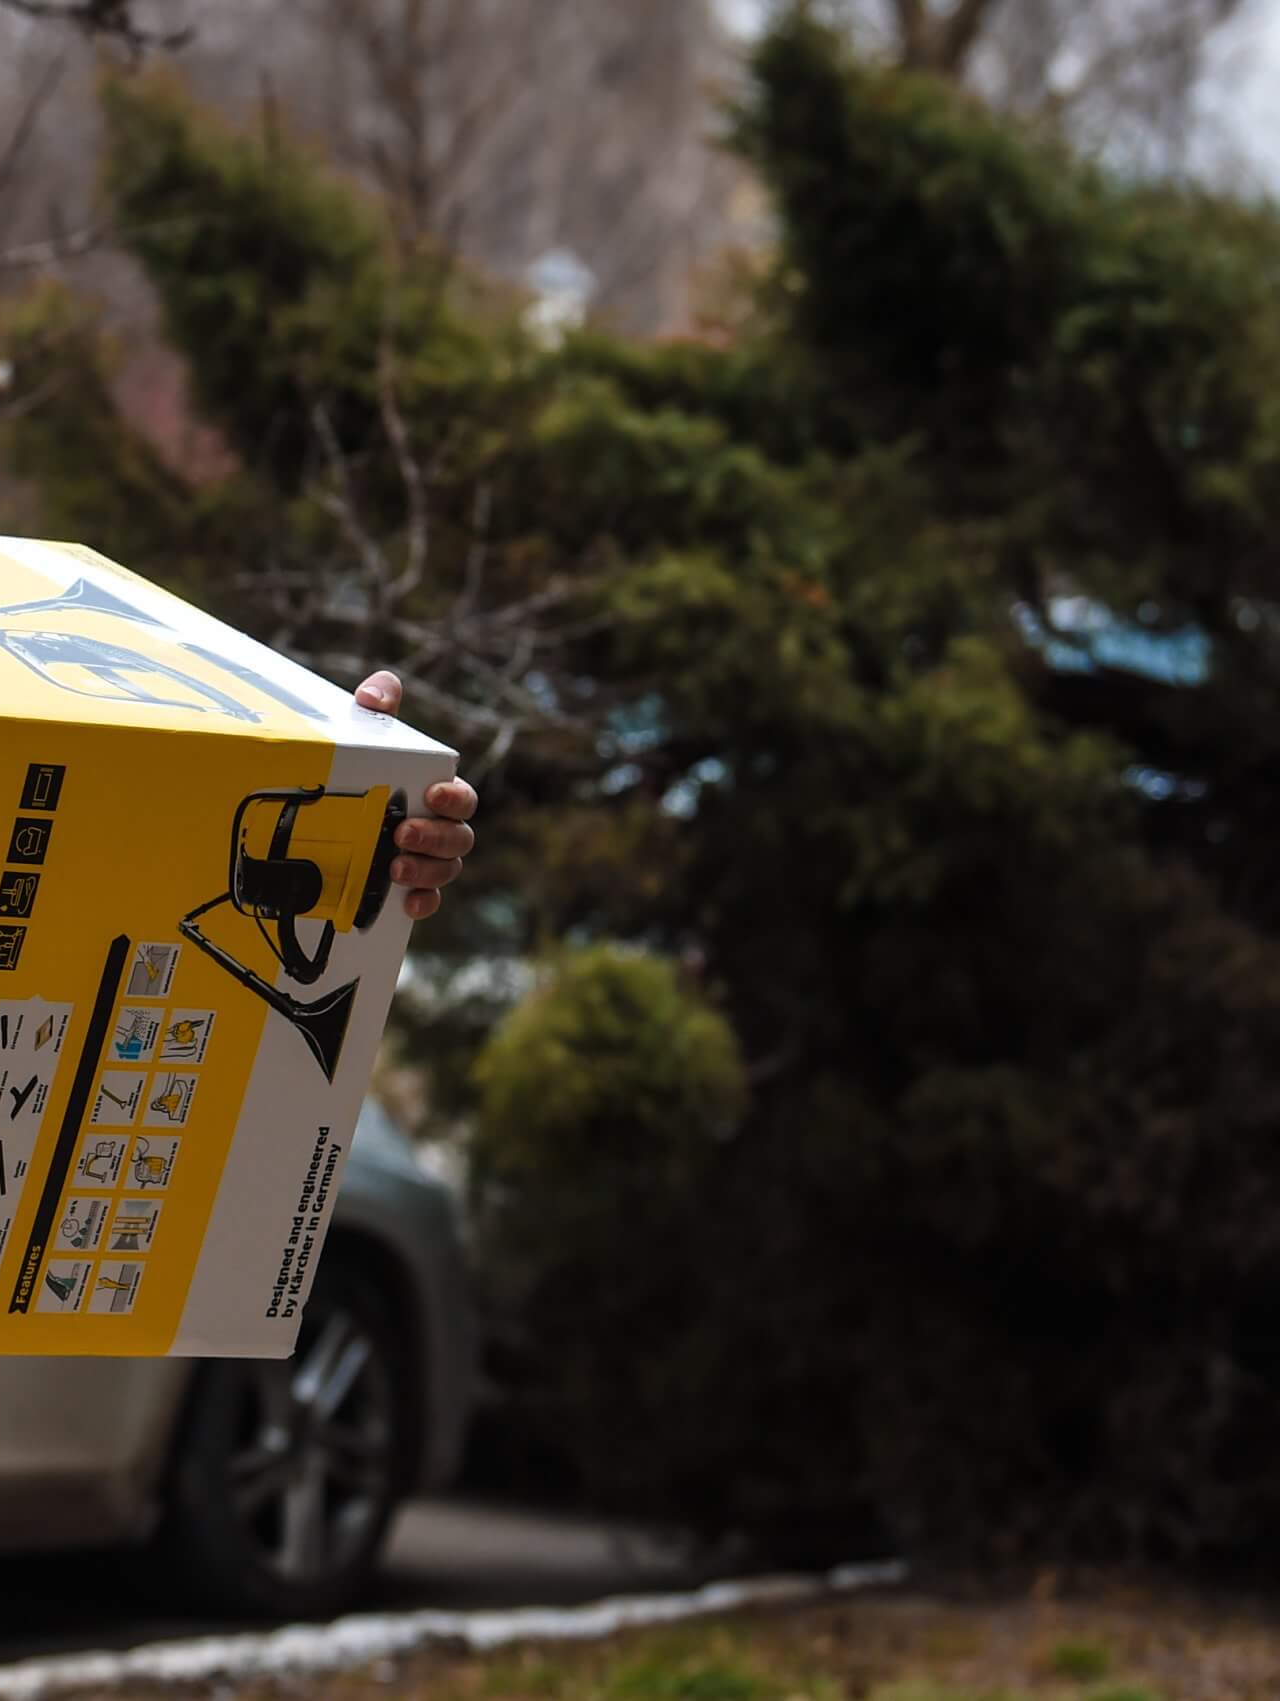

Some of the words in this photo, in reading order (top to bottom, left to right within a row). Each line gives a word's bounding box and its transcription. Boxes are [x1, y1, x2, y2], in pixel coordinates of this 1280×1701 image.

[312, 1144, 341, 1212] Germany
[266, 1248, 295, 1317] Designed
[289, 1217, 304, 1244] and
[298, 1127, 329, 1212] engineered
[306, 1217, 319, 1230] in
[16, 1246, 40, 1303] Features
[288, 1235, 313, 1294] Kärcher
[281, 1299, 297, 1317] by
